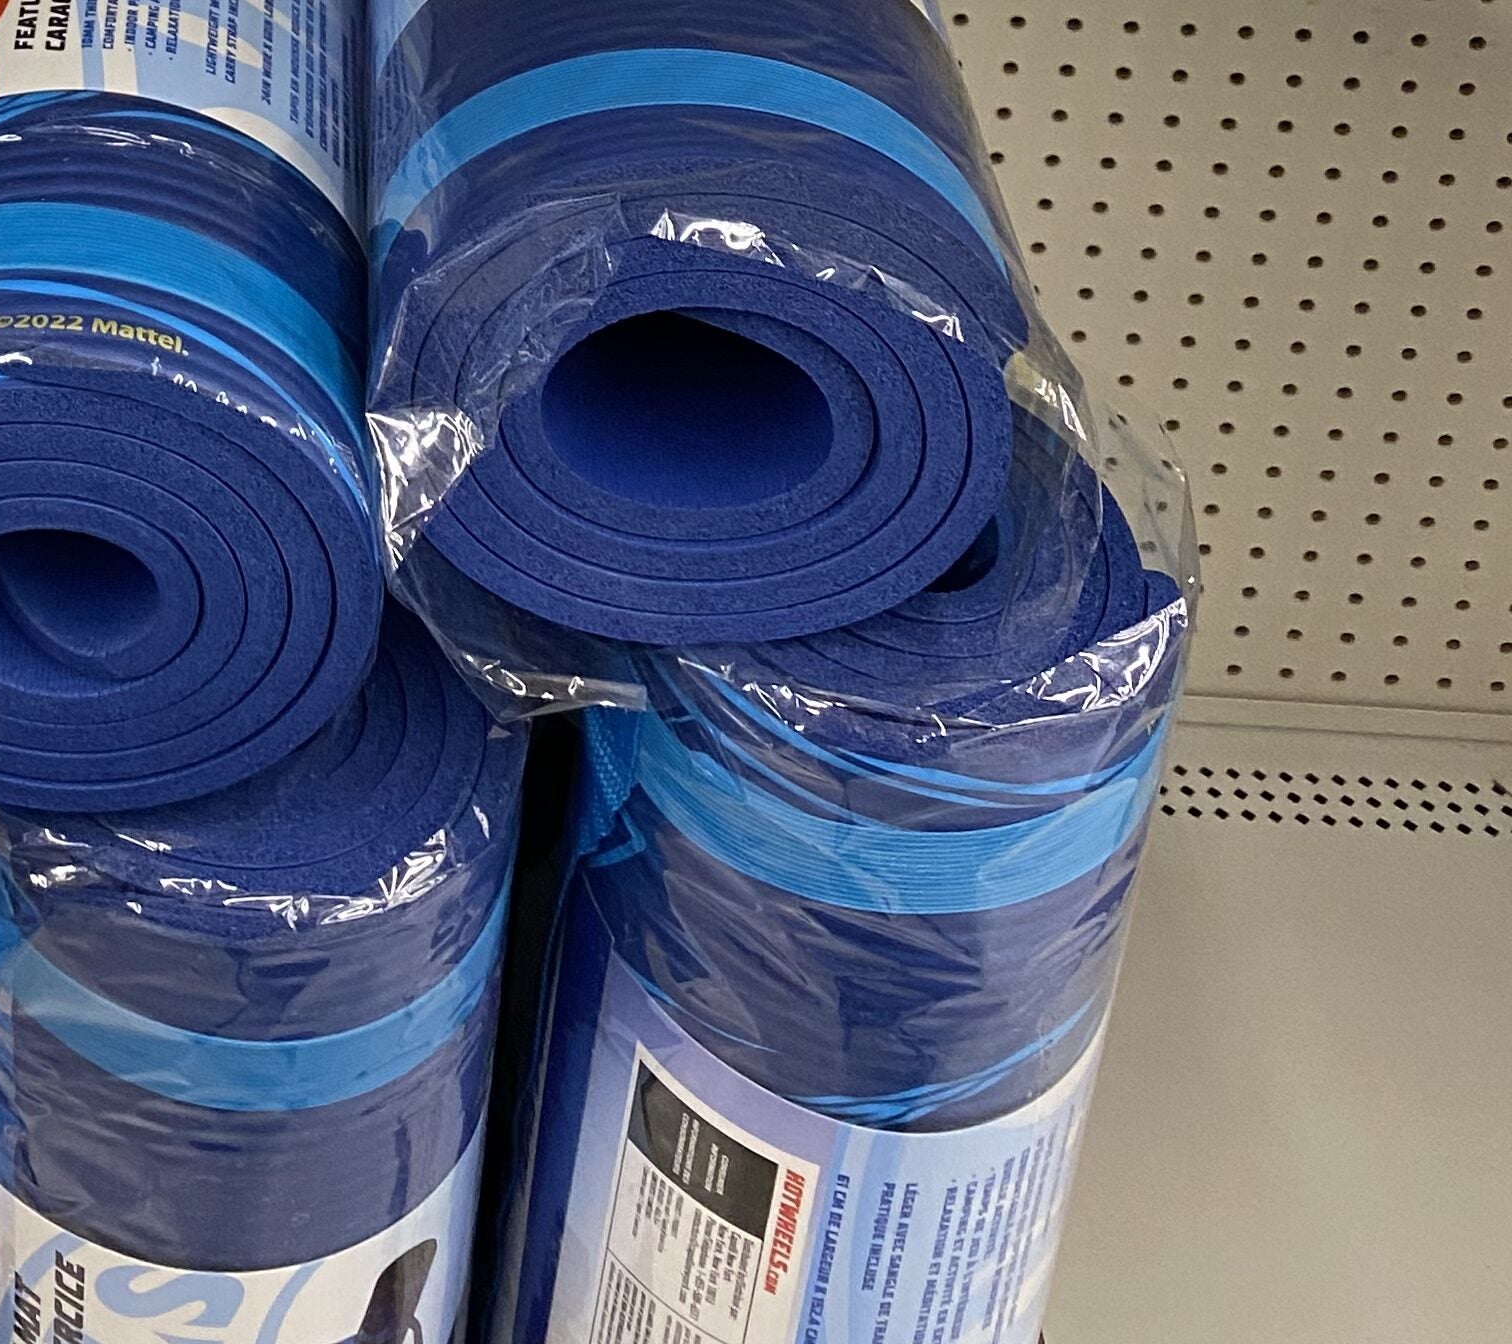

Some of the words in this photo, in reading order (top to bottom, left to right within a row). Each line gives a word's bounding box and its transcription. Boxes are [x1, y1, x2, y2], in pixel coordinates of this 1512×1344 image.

[872, 1182, 896, 1241] PRATIQUE
[892, 1223, 909, 1252] AVEC
[861, 1241, 881, 1291] INCLUSE
[882, 1255, 902, 1300] SANGLE
